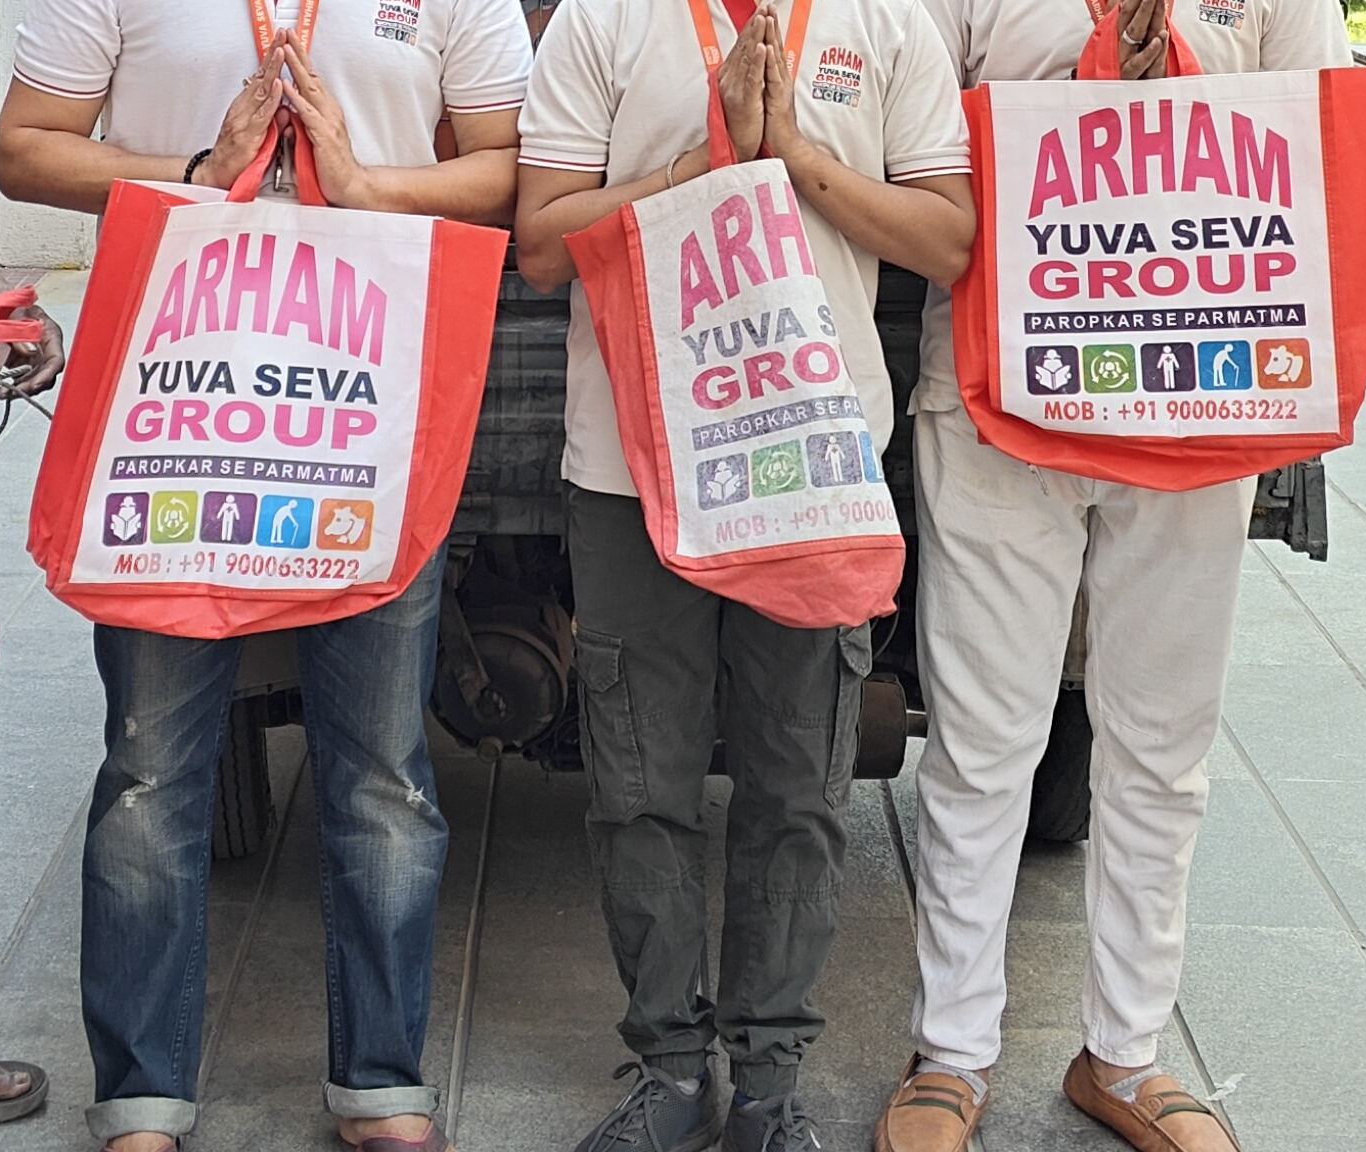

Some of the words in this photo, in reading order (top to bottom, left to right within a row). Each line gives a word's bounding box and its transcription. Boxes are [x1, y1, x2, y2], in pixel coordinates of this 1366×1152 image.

[378, 10, 417, 25] GROUP
[816, 74, 859, 87] GROUP
[819, 47, 863, 74] ARHAM
[1027, 99, 1293, 220] ARHAM
[680, 181, 816, 331] ARH
[1025, 222, 1157, 256] YUVA
[1171, 214, 1295, 250] SEVA
[1028, 252, 1297, 300] GROUP
[142, 232, 388, 367] ARHAM
[1031, 313, 1145, 331] PAROPKAR
[1152, 312, 1178, 328] SE
[1185, 308, 1300, 326] PARMATMA
[681, 306, 809, 366] YUVA
[137, 360, 236, 396] YUVA
[253, 363, 378, 405] SEVA
[692, 341, 841, 411] GRO
[124, 399, 378, 450] GROUP
[700, 405, 808, 445] PAROPKAR
[814, 400, 838, 416] SE
[1043, 400, 1096, 422] MOB
[1118, 400, 1157, 422] +91
[1166, 399, 1298, 422] 9000633222
[115, 456, 213, 475] PAROPKAR
[220, 460, 246, 475] SE
[253, 461, 370, 484] PARMATMA
[715, 514, 767, 544] MOB
[789, 504, 831, 530] +91
[839, 499, 895, 524] 90006
[113, 553, 161, 574] MOB
[179, 551, 215, 573] +91
[226, 553, 360, 580] 9000633222
